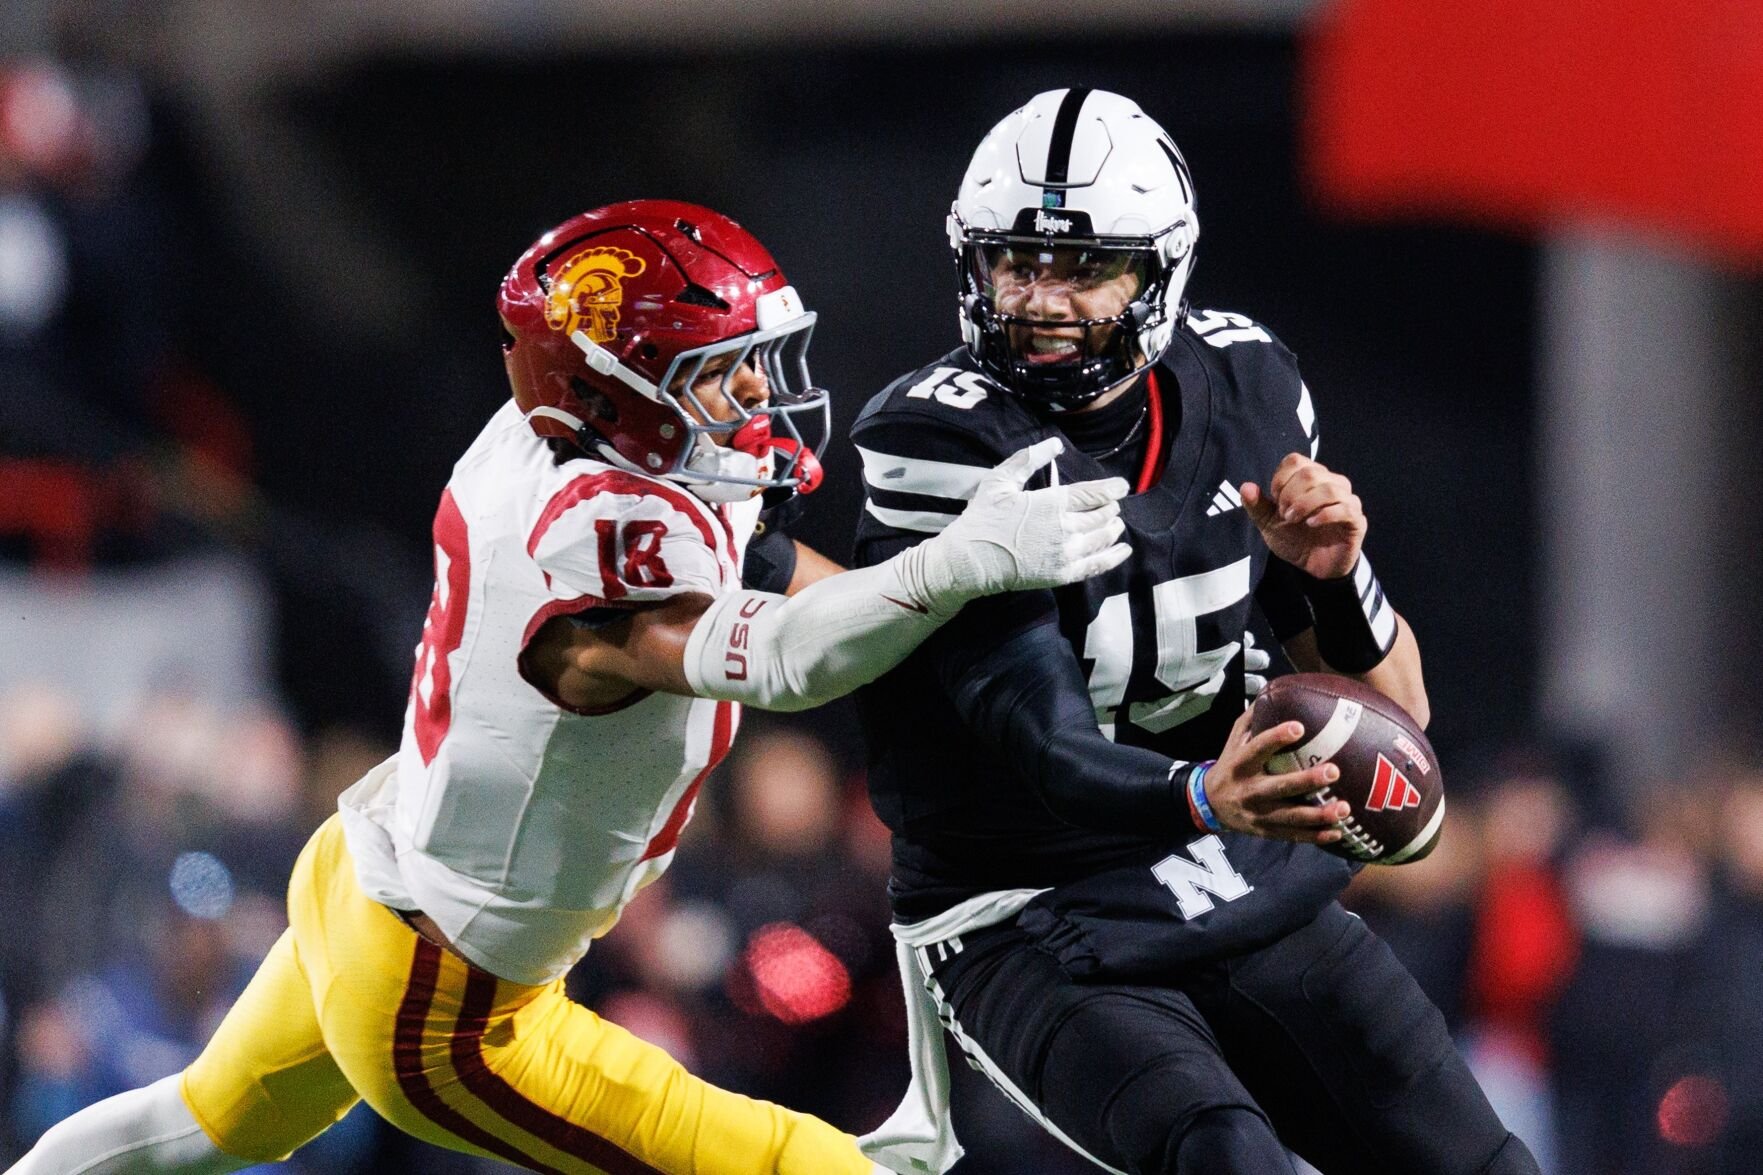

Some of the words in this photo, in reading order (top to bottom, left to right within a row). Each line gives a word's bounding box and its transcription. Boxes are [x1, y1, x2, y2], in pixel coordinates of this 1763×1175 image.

[1186, 309, 1273, 349] 15
[906, 366, 989, 410] 15
[594, 518, 674, 600] 18
[724, 597, 767, 681] USC
[1083, 555, 1251, 744] 15
[1150, 833, 1250, 921] N
